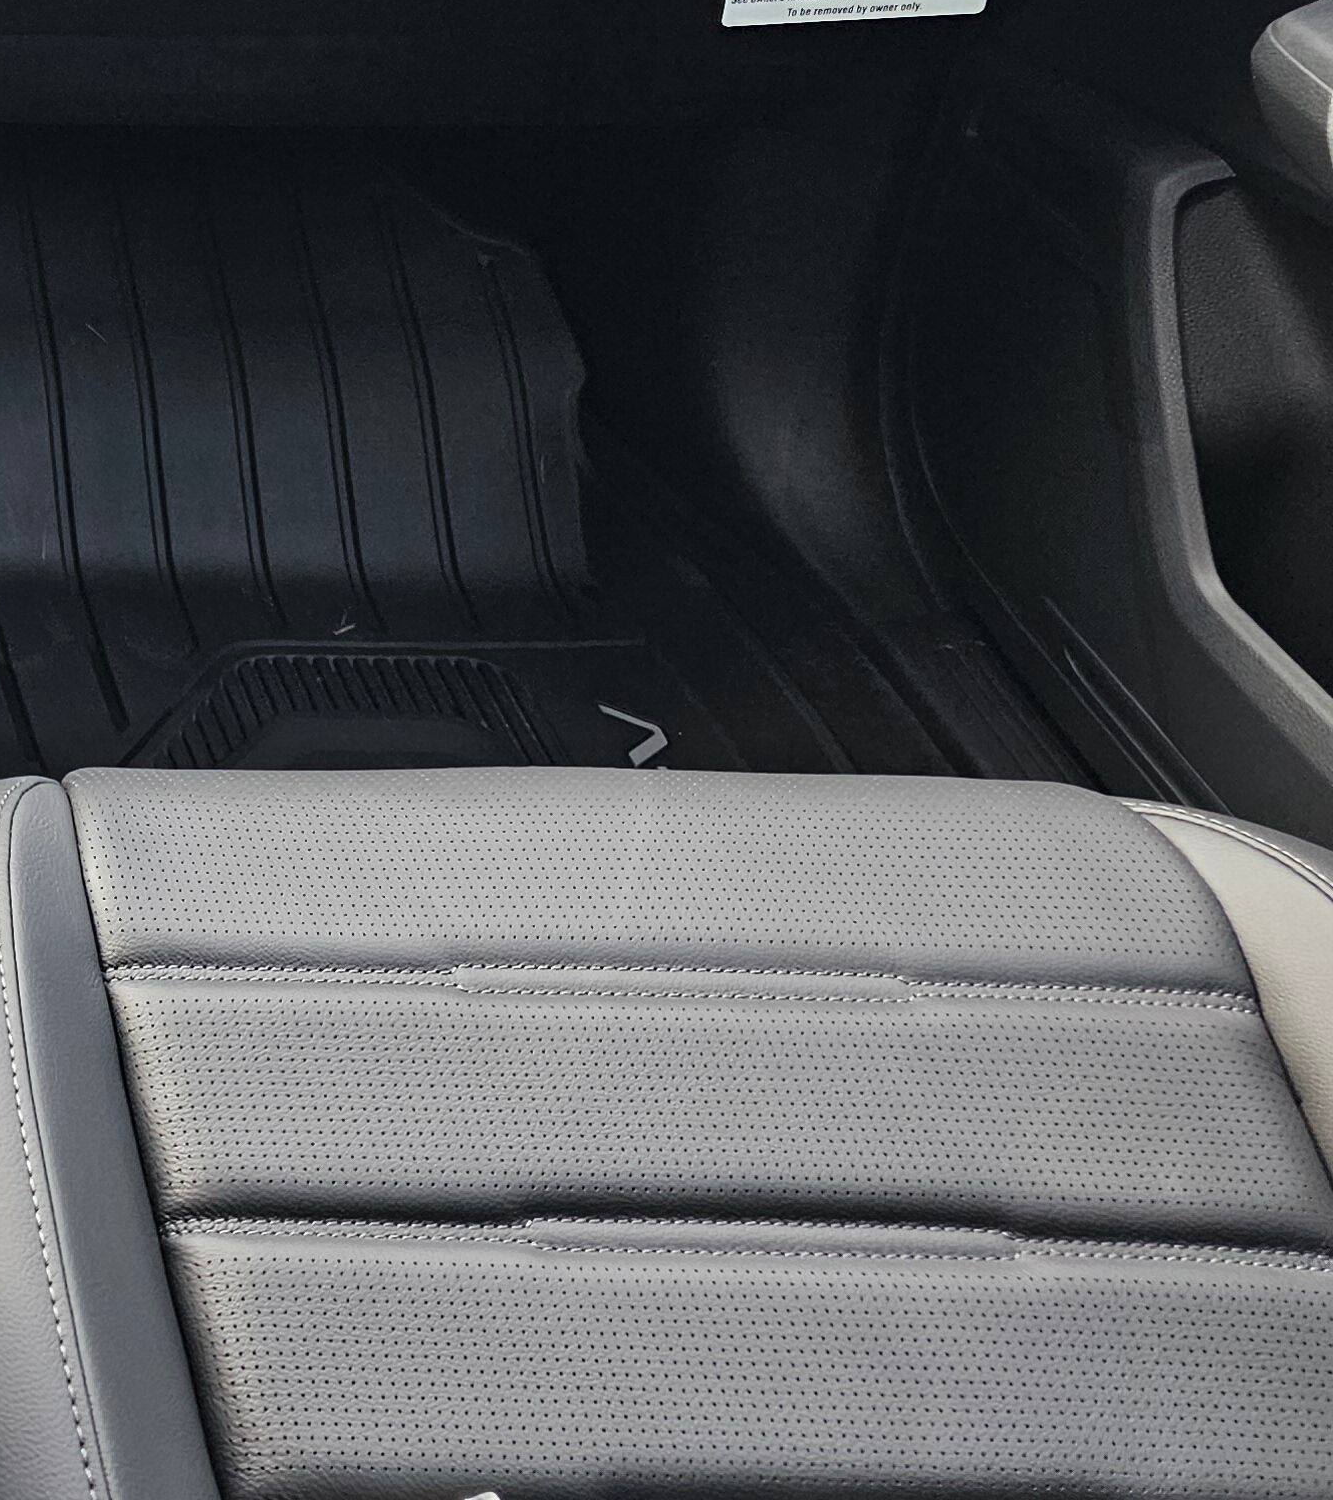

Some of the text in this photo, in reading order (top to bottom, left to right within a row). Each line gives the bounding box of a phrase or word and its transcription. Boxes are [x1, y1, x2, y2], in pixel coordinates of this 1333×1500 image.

[787, 2, 923, 17] To be removed by owner only.
